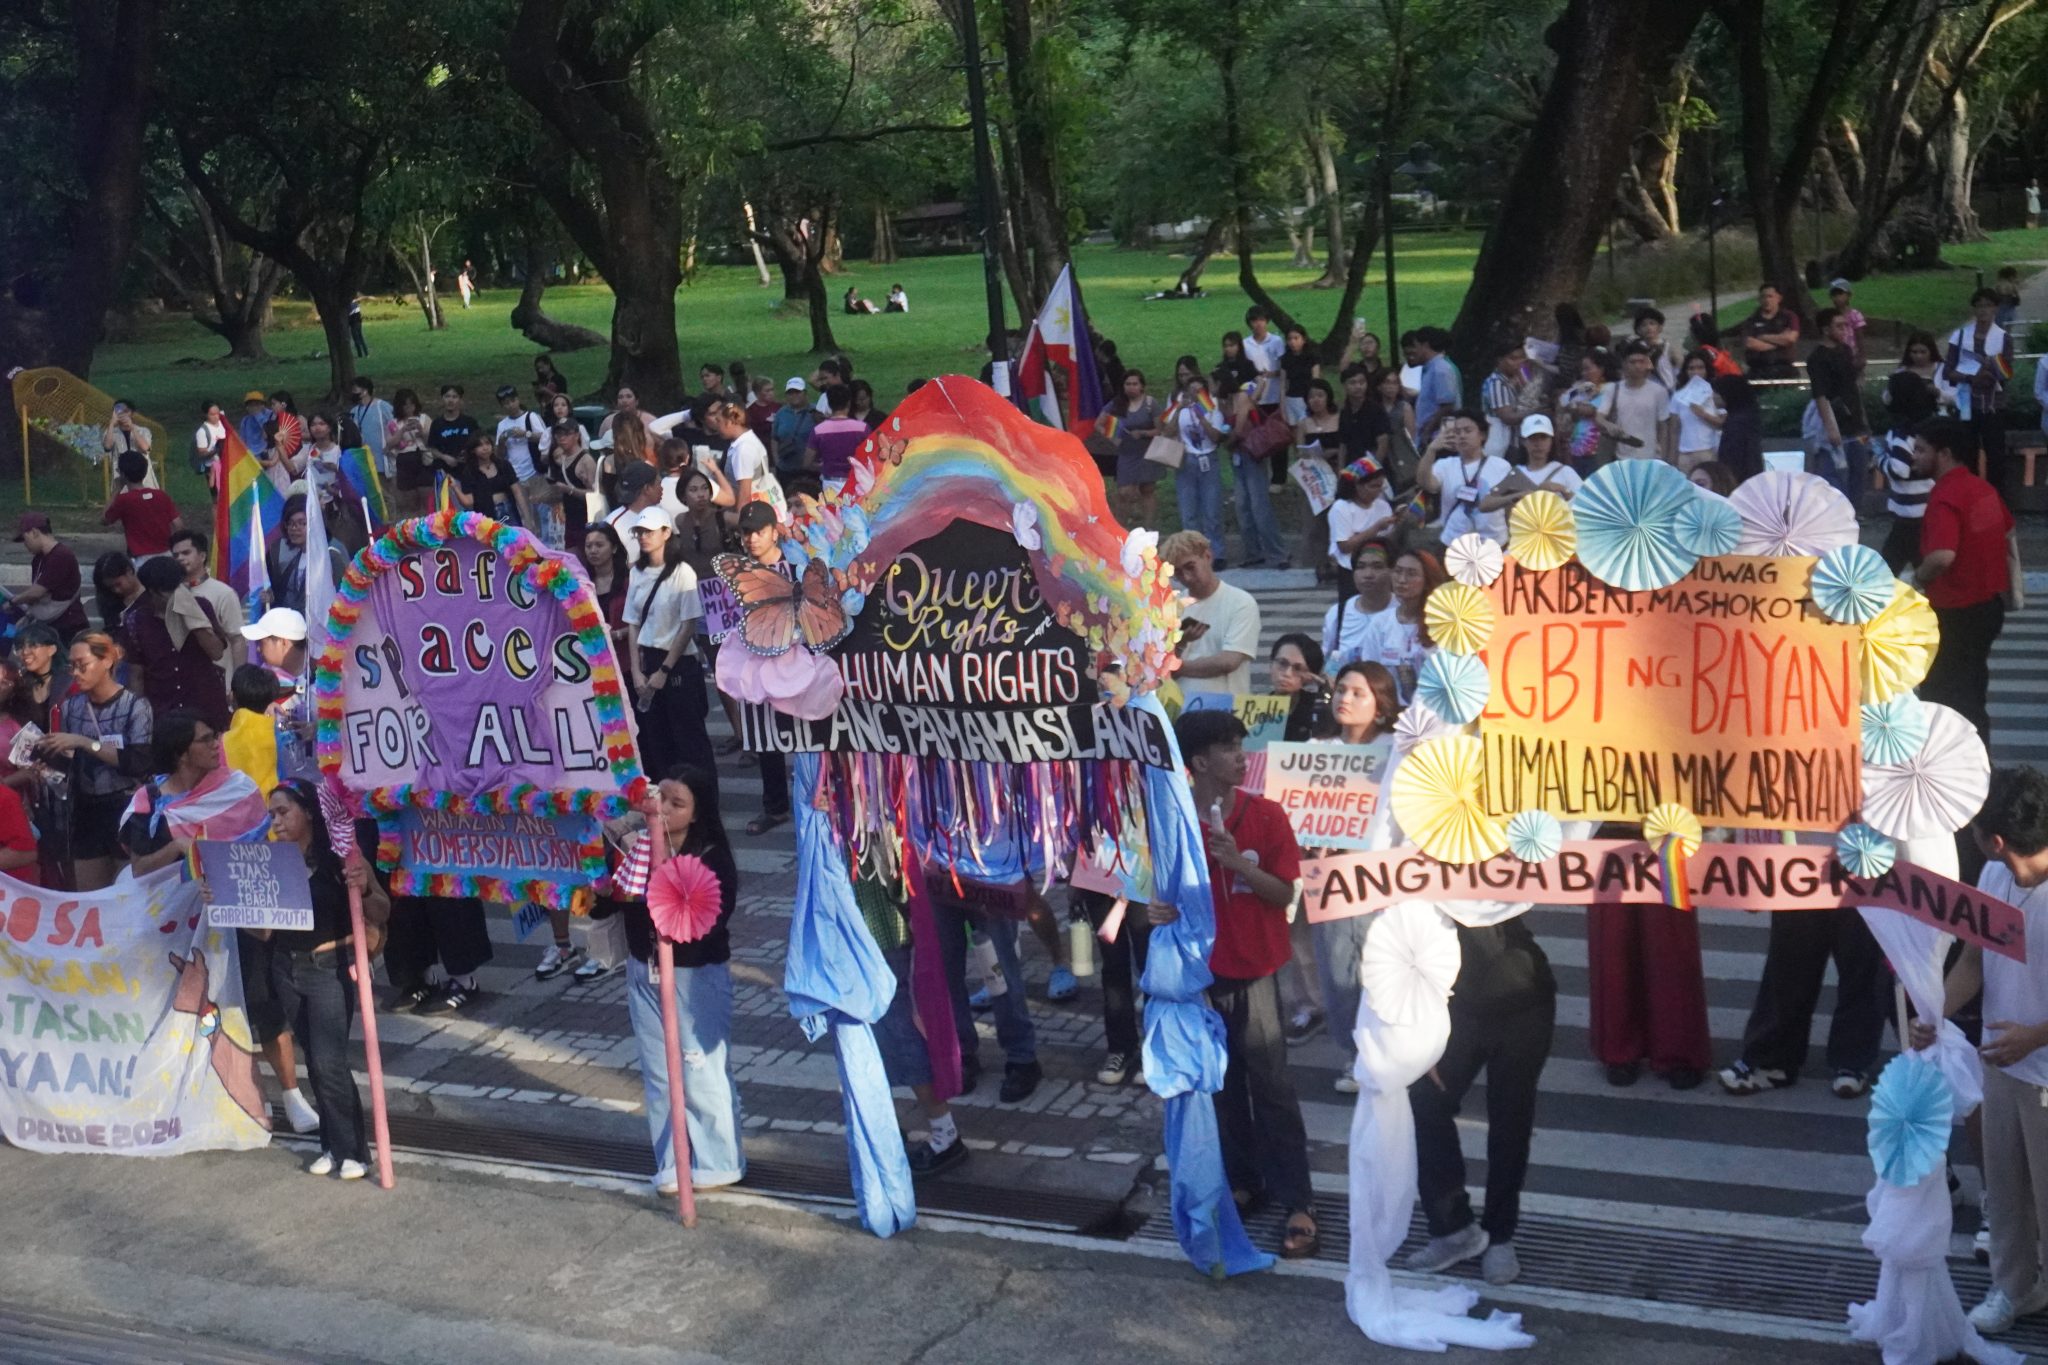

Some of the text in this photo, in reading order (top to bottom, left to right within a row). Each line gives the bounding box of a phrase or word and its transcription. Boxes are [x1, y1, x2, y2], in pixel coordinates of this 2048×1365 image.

[701, 579, 723, 598] NO
[886, 552, 1042, 624] Queer
[1686, 561, 1779, 584] UWAG
[884, 605, 1028, 654] Rights
[842, 646, 1080, 704] HUMAN RIGHTS
[1627, 655, 1682, 688] NG
[1690, 622, 1850, 737] BAYAN
[346, 704, 441, 773] FOR
[828, 698, 902, 753] ANG
[1281, 753, 1376, 773] JUSTICE
[1483, 732, 1857, 822] LUMALABAN MAKABAYAN
[1309, 773, 1347, 788] FOR
[515, 814, 557, 836] ANG
[1297, 811, 1369, 839] AUDE!
[229, 843, 271, 861] SAHOD
[237, 879, 280, 894] PRESYO
[1320, 857, 1432, 910] ANG
[1559, 851, 1819, 899] BAKANG
[210, 907, 308, 925] GABRIELA YOUTH
[0, 993, 146, 1044] TASAN
[112, 1116, 182, 1148] 2024
